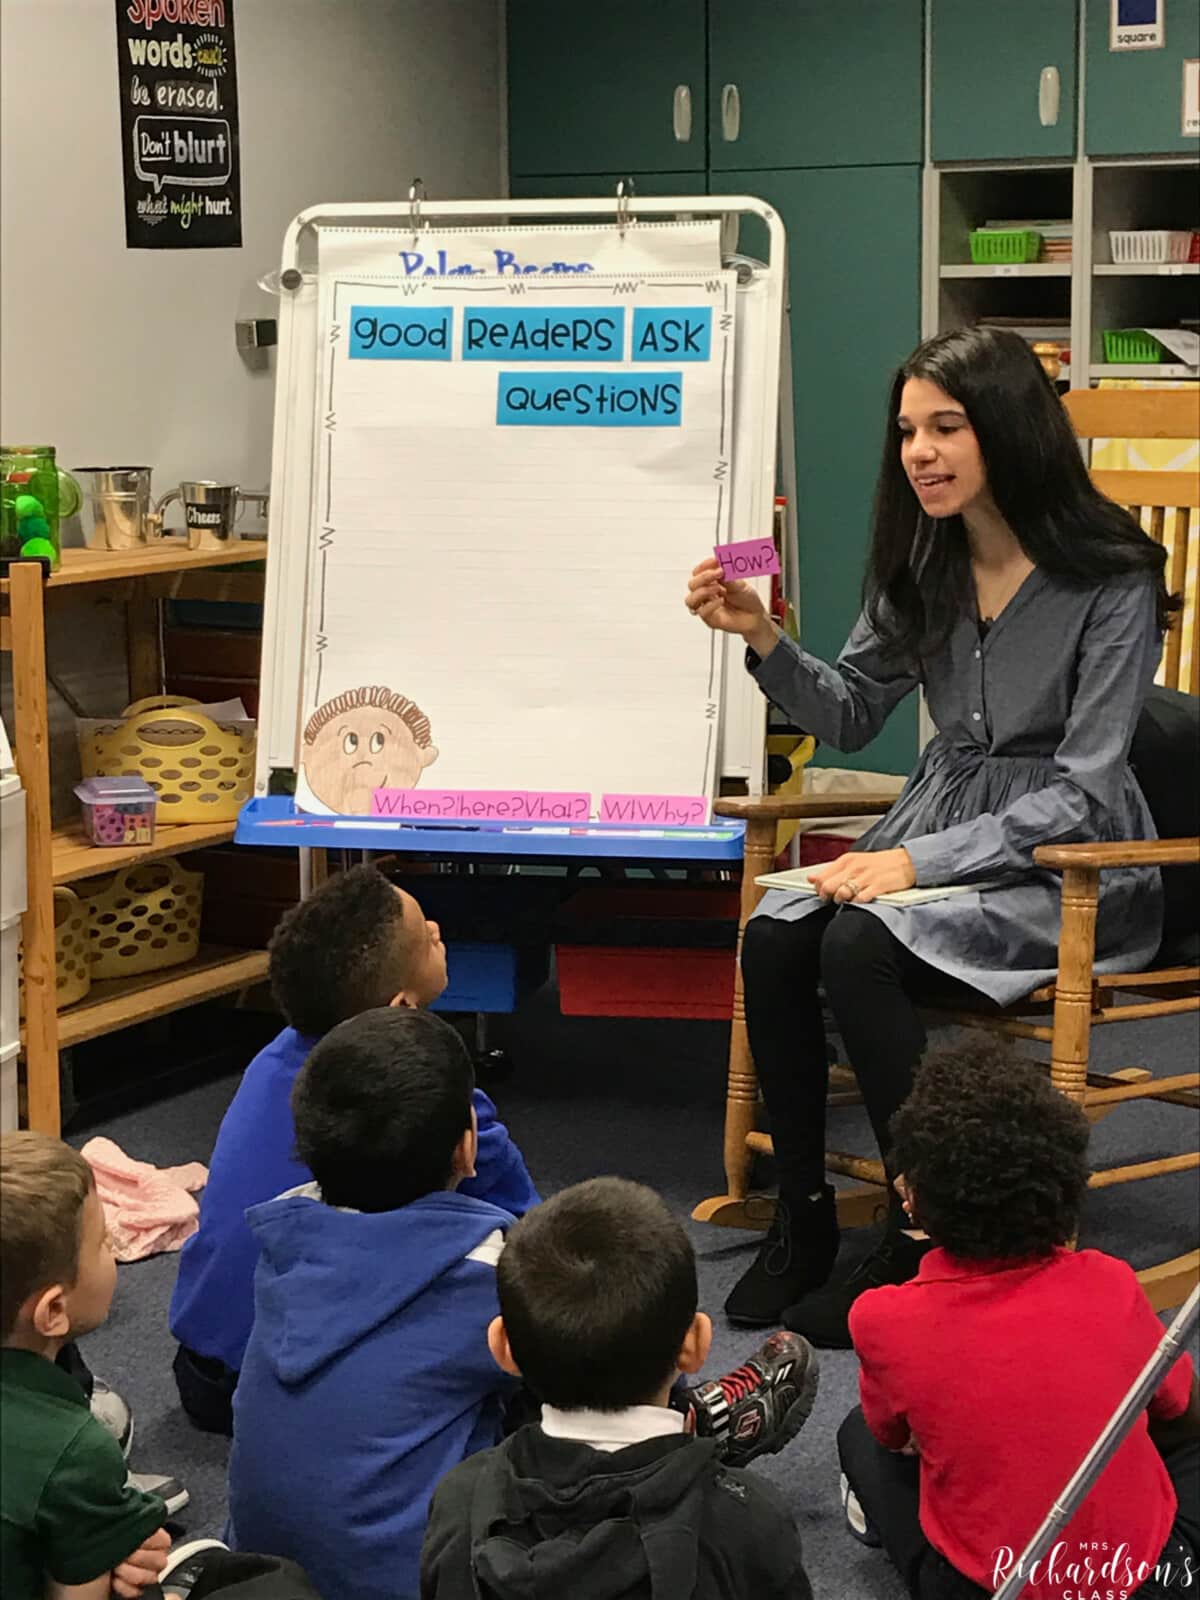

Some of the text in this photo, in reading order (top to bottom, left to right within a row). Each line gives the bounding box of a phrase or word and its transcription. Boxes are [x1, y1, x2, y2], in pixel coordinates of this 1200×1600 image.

[128, 33, 193, 69] words
[1117, 32, 1157, 44] square
[131, 75, 224, 111] be erased.
[140, 130, 227, 164] Don't blurt
[170, 192, 204, 229] might
[205, 195, 233, 215] hurt.
[354, 317, 448, 350] good
[719, 545, 775, 574] How?
[374, 794, 456, 816] When?
[637, 799, 704, 826] Why?
